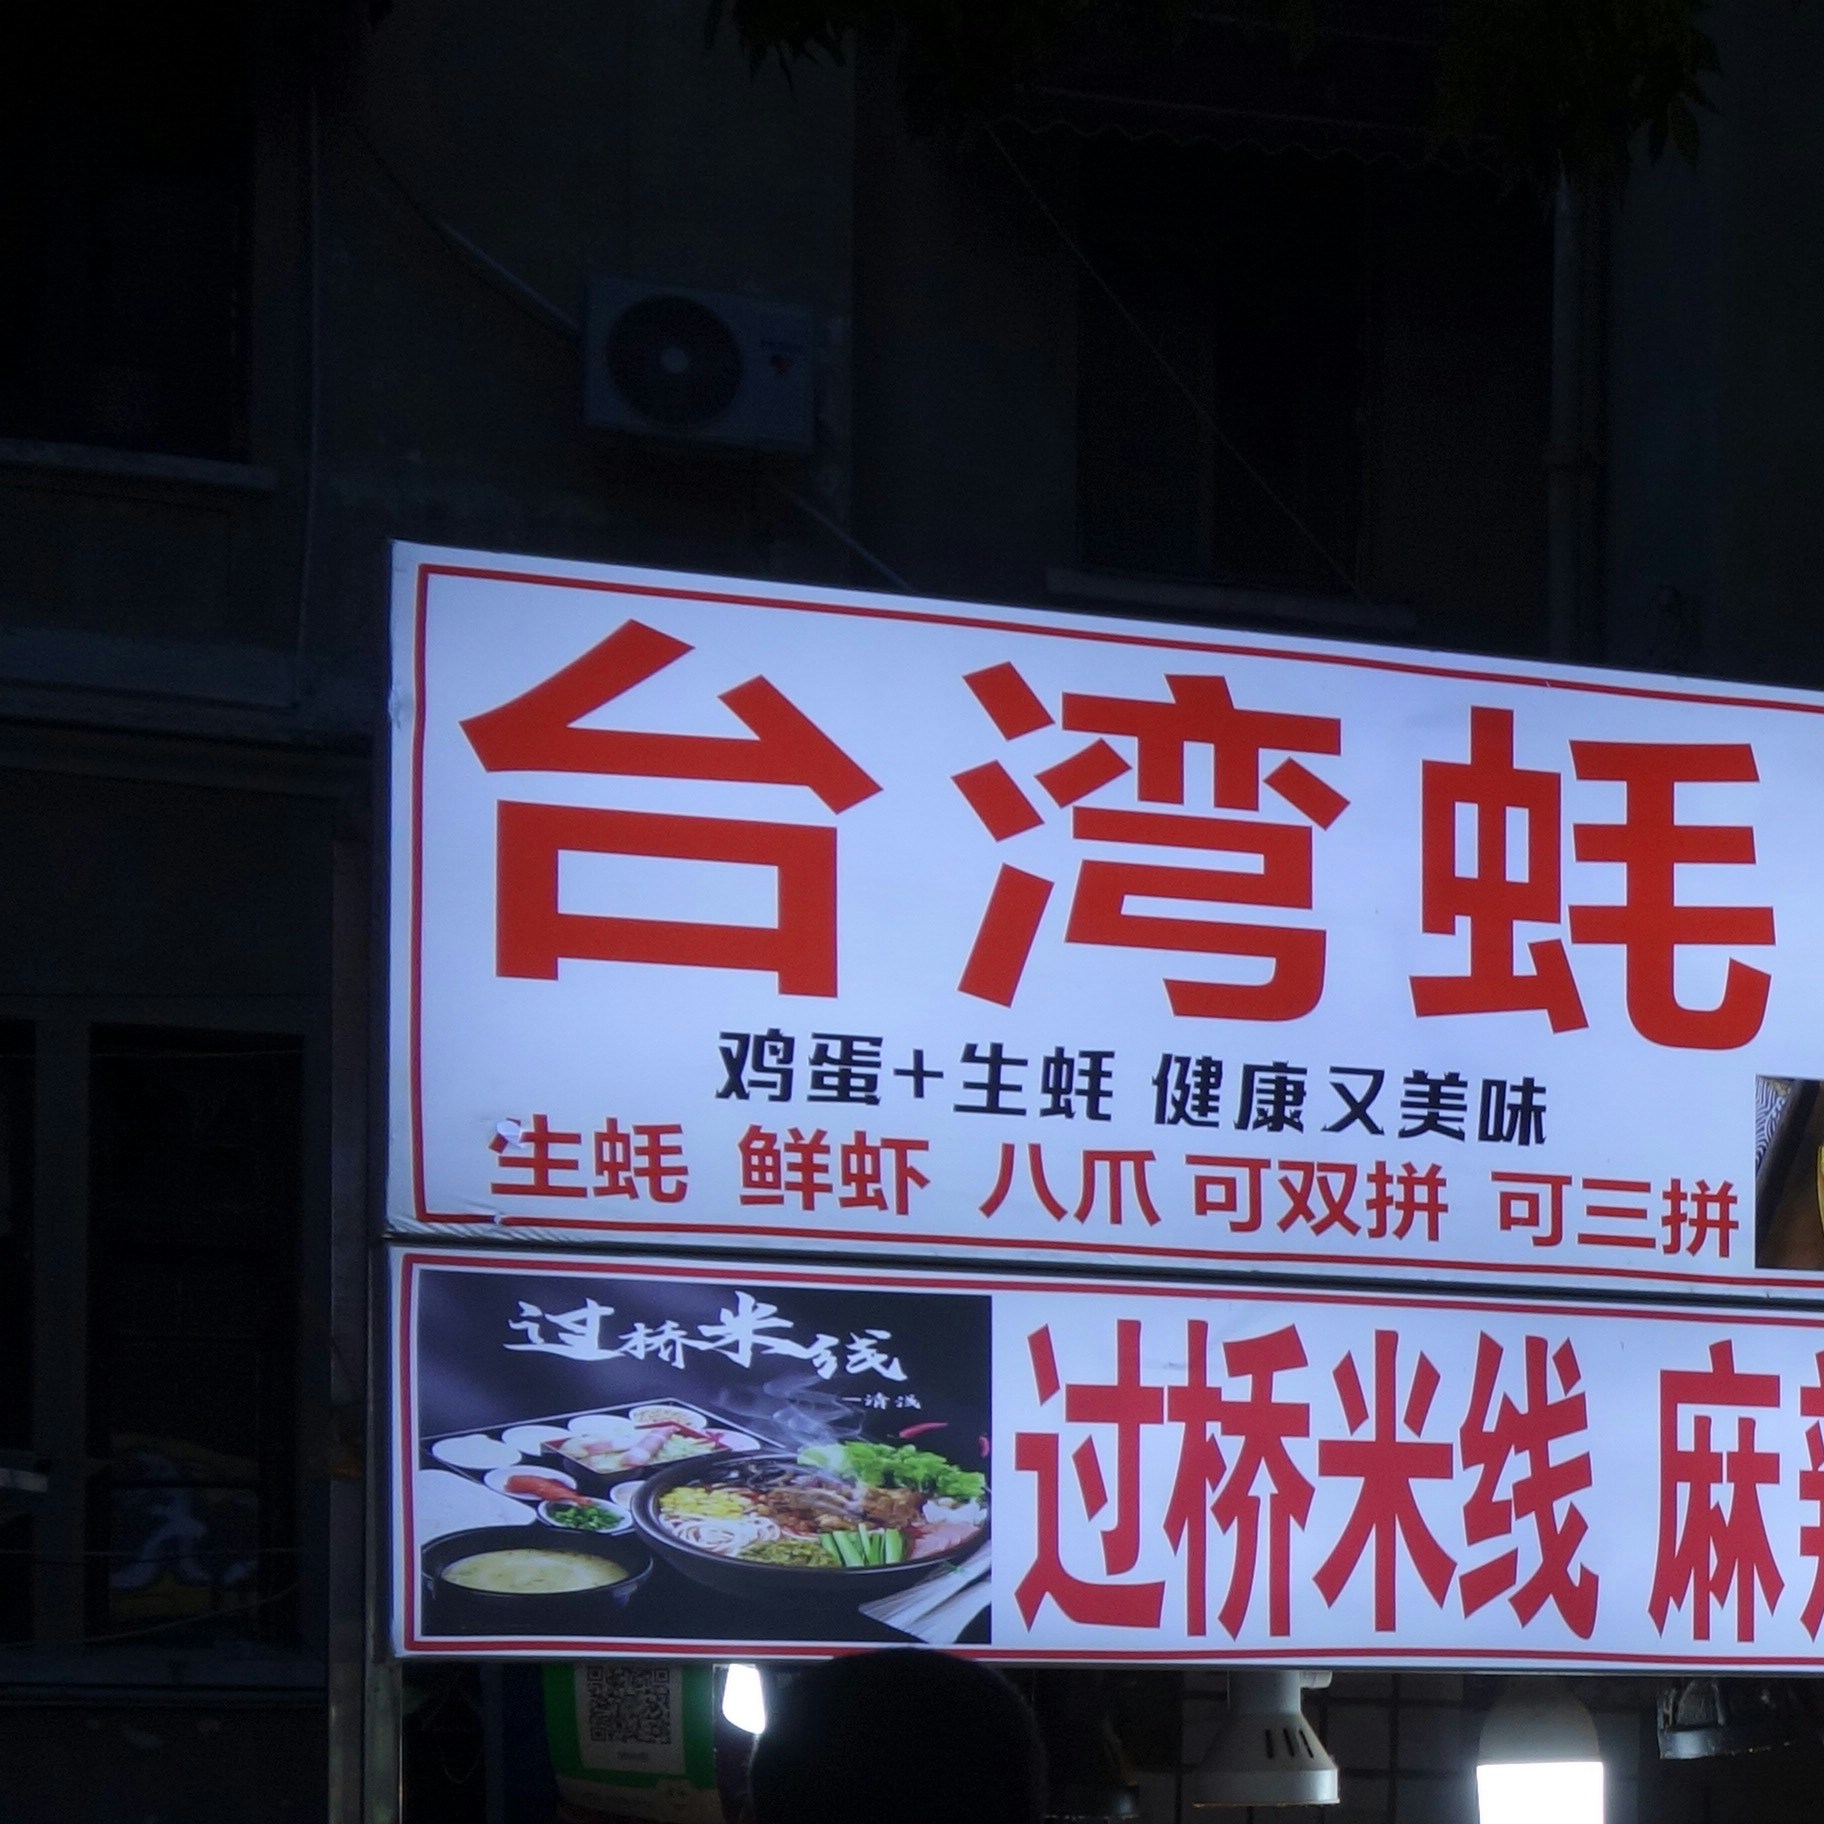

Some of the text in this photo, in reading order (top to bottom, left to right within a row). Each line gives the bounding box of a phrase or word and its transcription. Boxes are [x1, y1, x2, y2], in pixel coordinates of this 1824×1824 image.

[716, 1028, 1547, 1146] 鸡蛋+生蚝 健康又美味
[489, 1114, 1740, 1259] 生蚝 鲜虾 八爪 可双拼 可三拼
[502, 1290, 907, 1381] 过桥米线
[1014, 1319, 1599, 1641] 过桥米线
